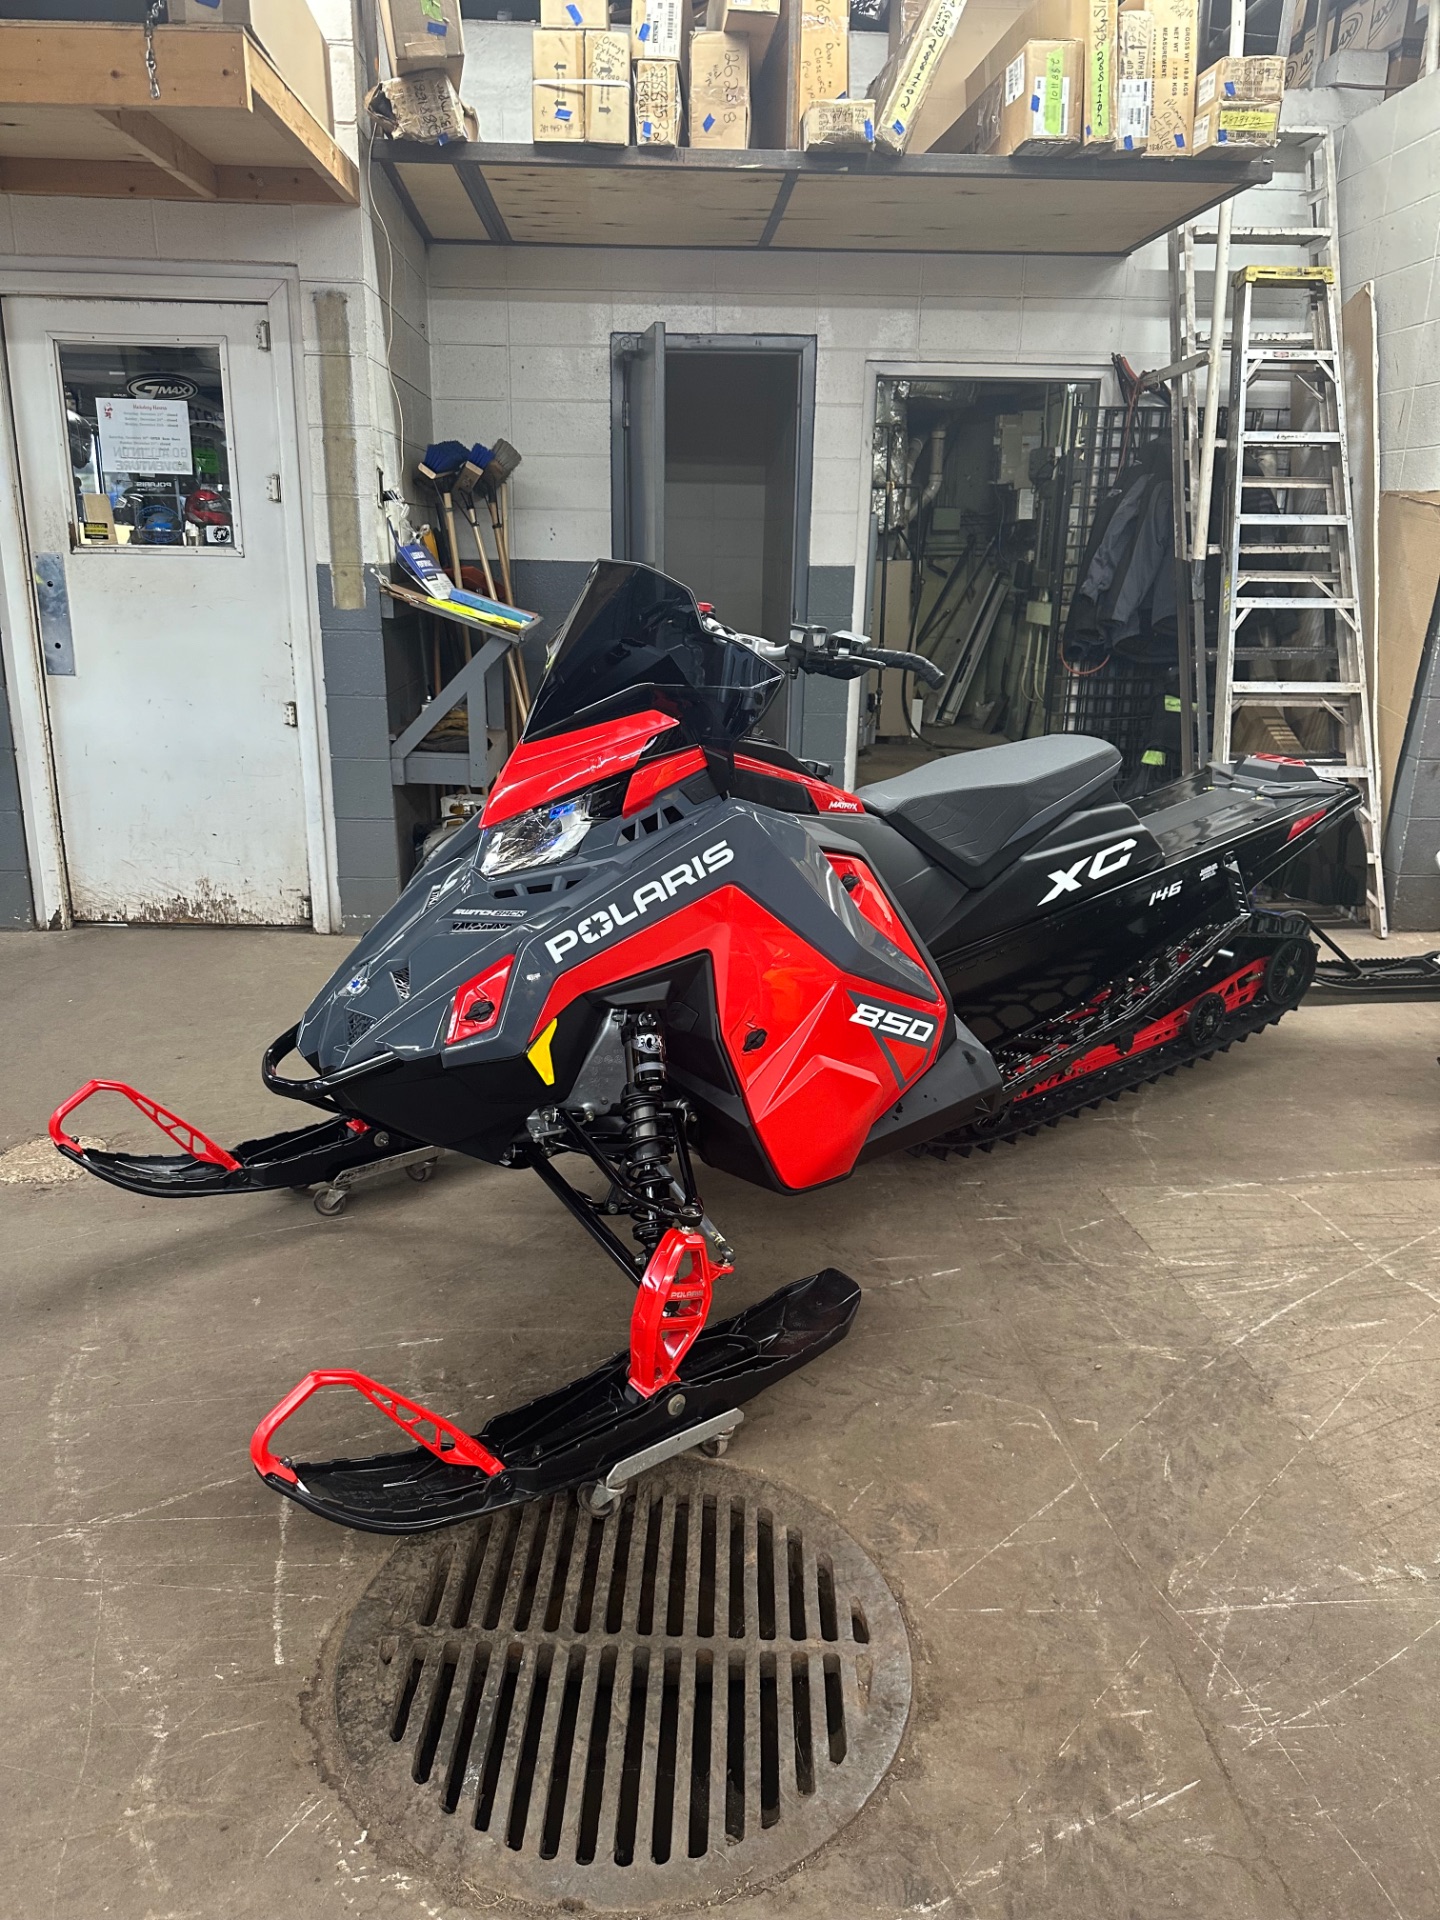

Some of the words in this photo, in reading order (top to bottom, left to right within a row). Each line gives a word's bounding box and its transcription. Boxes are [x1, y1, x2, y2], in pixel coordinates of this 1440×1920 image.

[1037, 838, 1138, 906] XC
[544, 839, 735, 964] POLARIS
[1147, 880, 1183, 907] 146
[636, 1033, 662, 1052] FOX
[849, 1001, 936, 1043] 850
